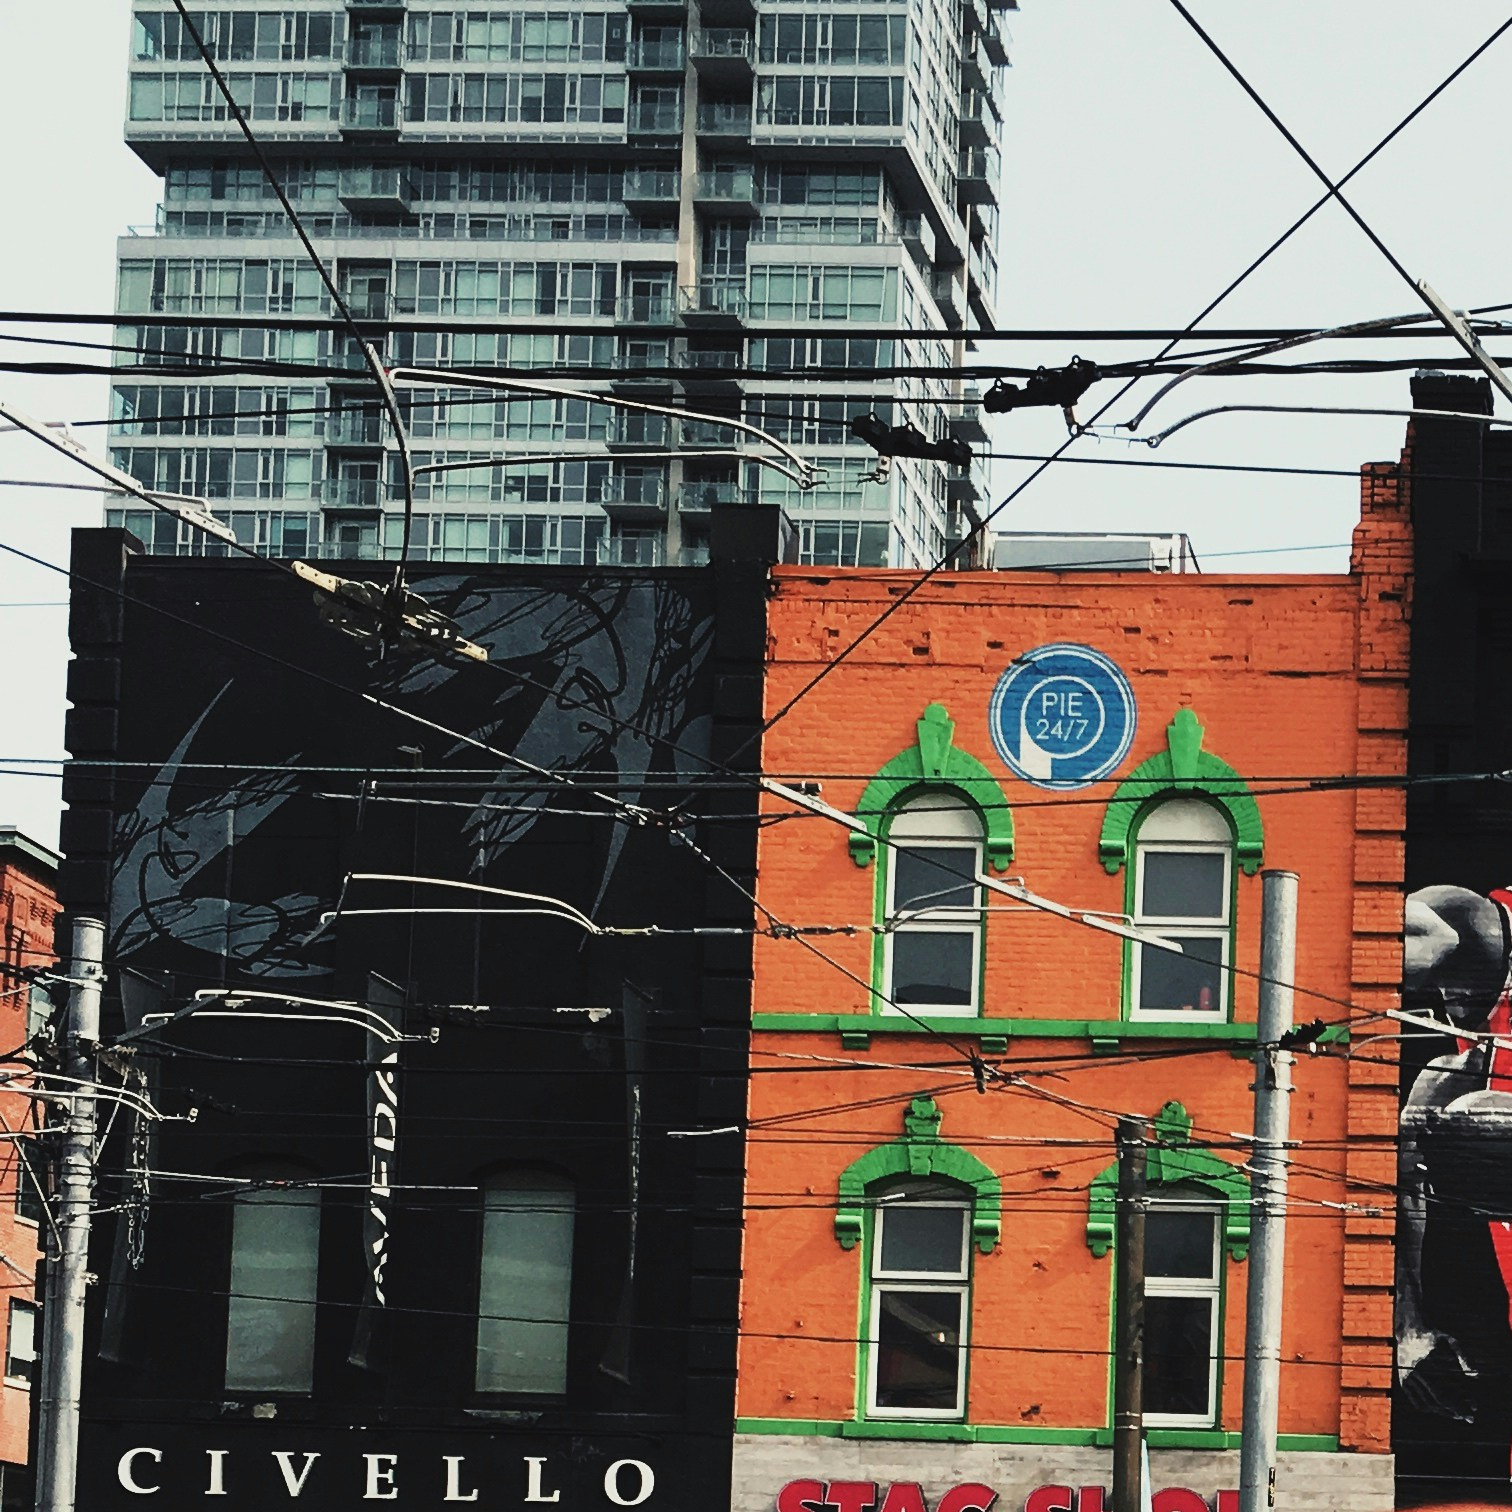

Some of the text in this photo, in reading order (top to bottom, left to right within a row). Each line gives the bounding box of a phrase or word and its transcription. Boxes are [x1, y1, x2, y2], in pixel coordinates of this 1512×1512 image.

[1042, 692, 1083, 717] PIE
[1036, 718, 1089, 742] 24/7
[117, 1447, 656, 1506] CIVELLO
